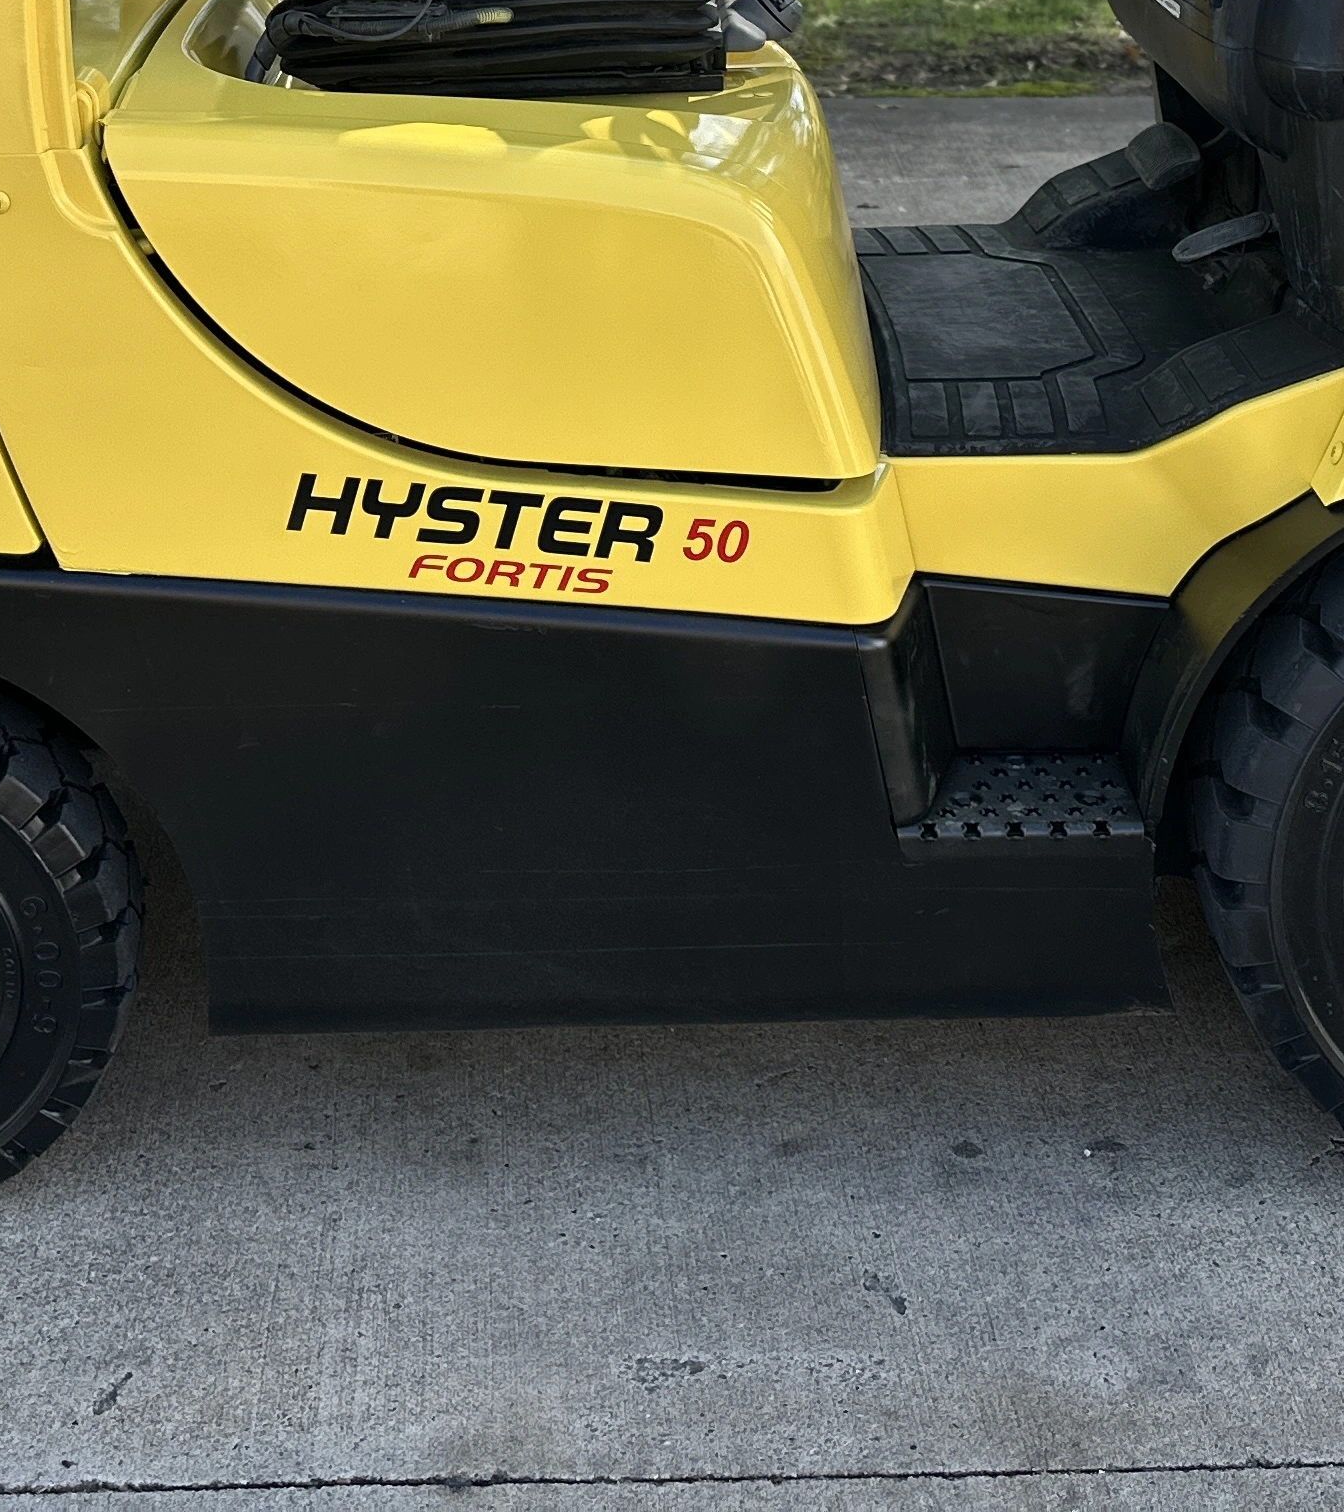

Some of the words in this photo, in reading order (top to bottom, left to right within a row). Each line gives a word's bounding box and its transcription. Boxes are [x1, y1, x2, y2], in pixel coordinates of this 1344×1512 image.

[286, 472, 664, 563] HYSTER
[682, 518, 750, 564] 50
[408, 554, 613, 594] FORTIS
[18, 894, 63, 1034] 6.00-9
